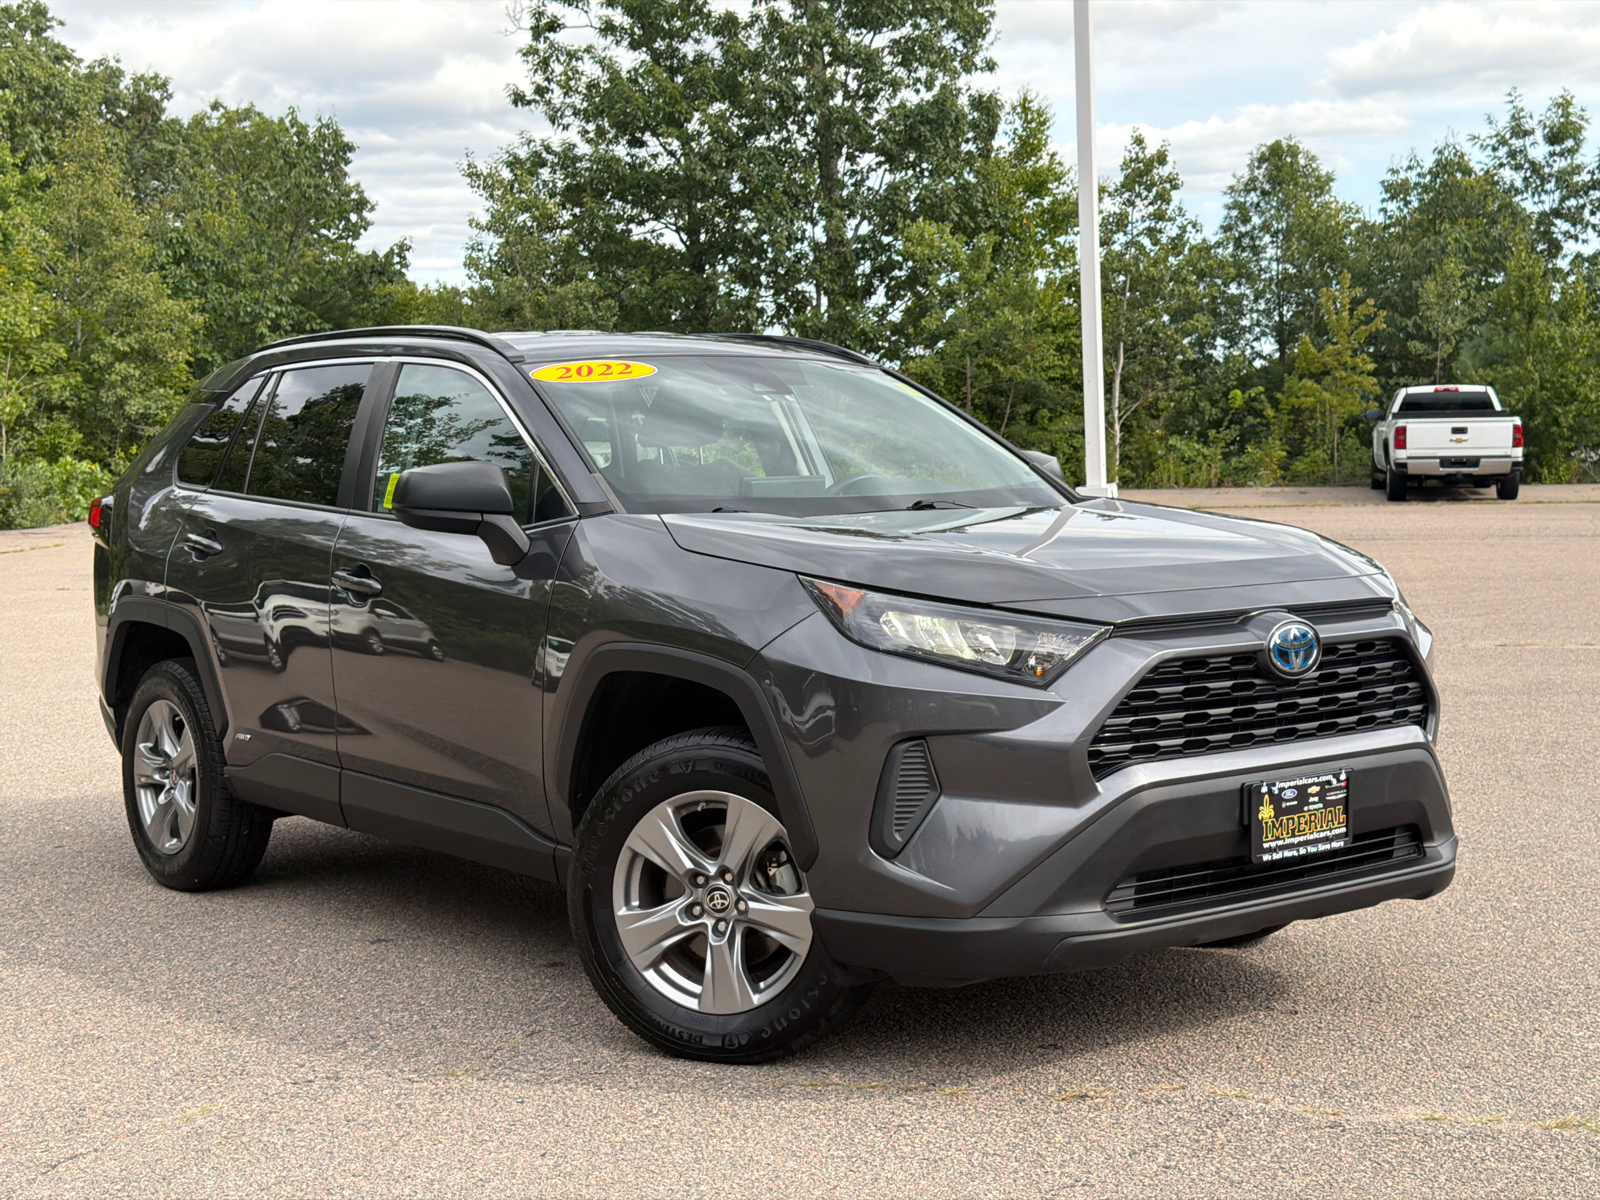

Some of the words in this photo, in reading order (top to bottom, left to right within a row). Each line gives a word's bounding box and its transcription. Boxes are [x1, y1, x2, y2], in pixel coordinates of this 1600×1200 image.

[556, 363, 633, 379] 2022
[1276, 775, 1333, 788] Imperialcars.com
[1263, 806, 1346, 841] IMPERIAL
[1263, 827, 1346, 848] www.imperialcars.com
[1272, 851, 1283, 860] Sell
[1299, 847, 1307, 855] So
[1306, 845, 1318, 854] You
[1317, 843, 1331, 851] Save
